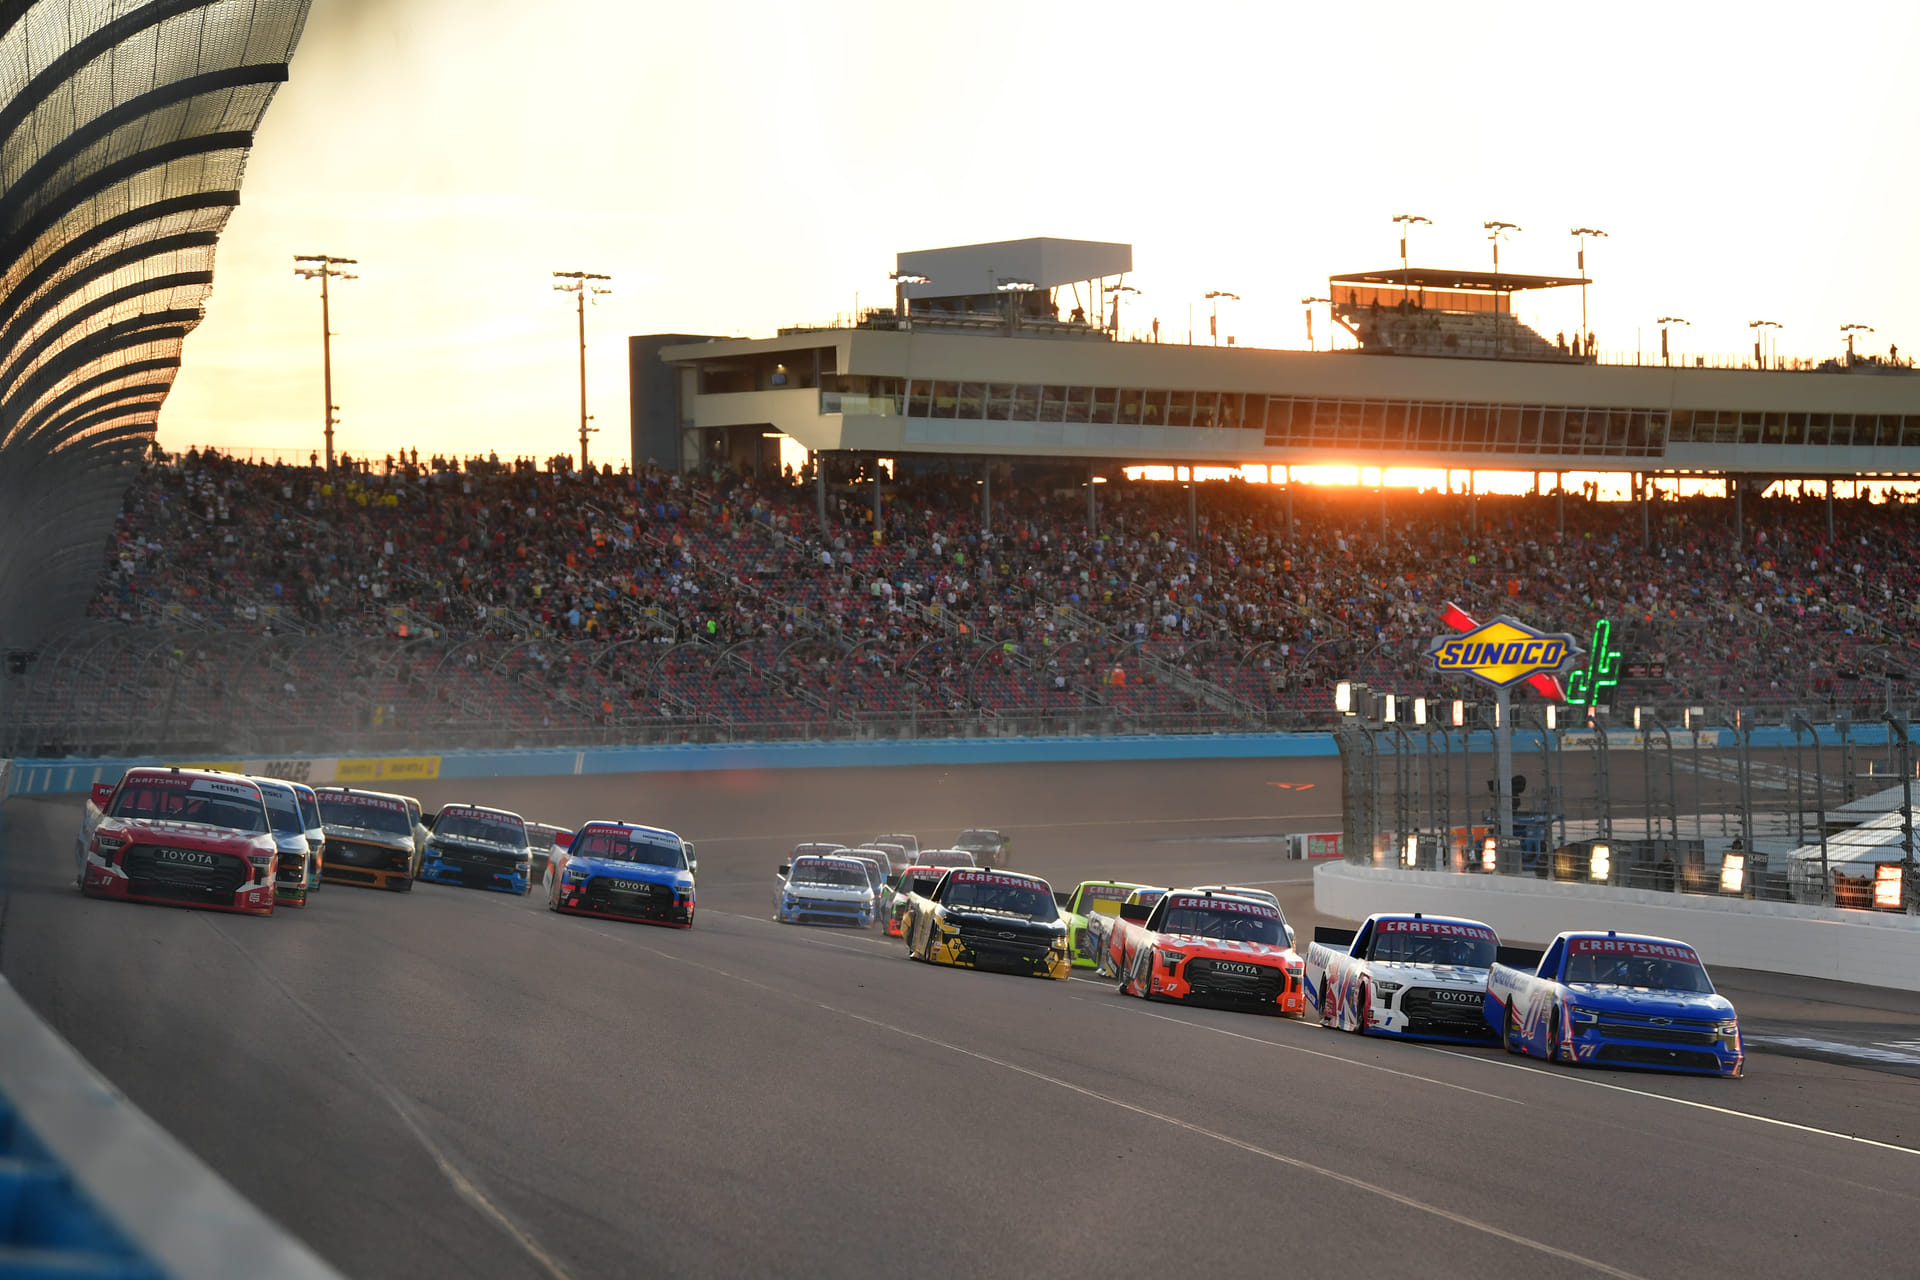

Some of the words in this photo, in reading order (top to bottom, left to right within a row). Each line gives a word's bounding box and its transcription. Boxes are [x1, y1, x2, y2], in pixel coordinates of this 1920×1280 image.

[1441, 642, 1562, 665] SUNOCO
[264, 761, 311, 783] DOGLEG
[129, 777, 187, 786] CRAFTSMAN
[211, 784, 240, 794] HEIM
[317, 792, 397, 810] CRAFTSMAN
[450, 809, 518, 825] CRAFTSMAN
[588, 828, 629, 836] CRAFTSMAN
[161, 850, 213, 865] TOYOTA
[801, 860, 859, 869] CRAFTSMAN
[614, 880, 650, 892] TOYOTA
[958, 873, 1041, 890] CRAFTSMAN
[1178, 898, 1272, 918] CRAFTSMAN
[1387, 921, 1490, 941] CRAFTSMAN
[1579, 940, 1690, 960] CRAFTSMAN
[1215, 962, 1258, 975] TOYOTA
[1166, 983, 1178, 992] 17
[1435, 991, 1482, 1003] TOYOTA
[1579, 1043, 1596, 1057] 71
